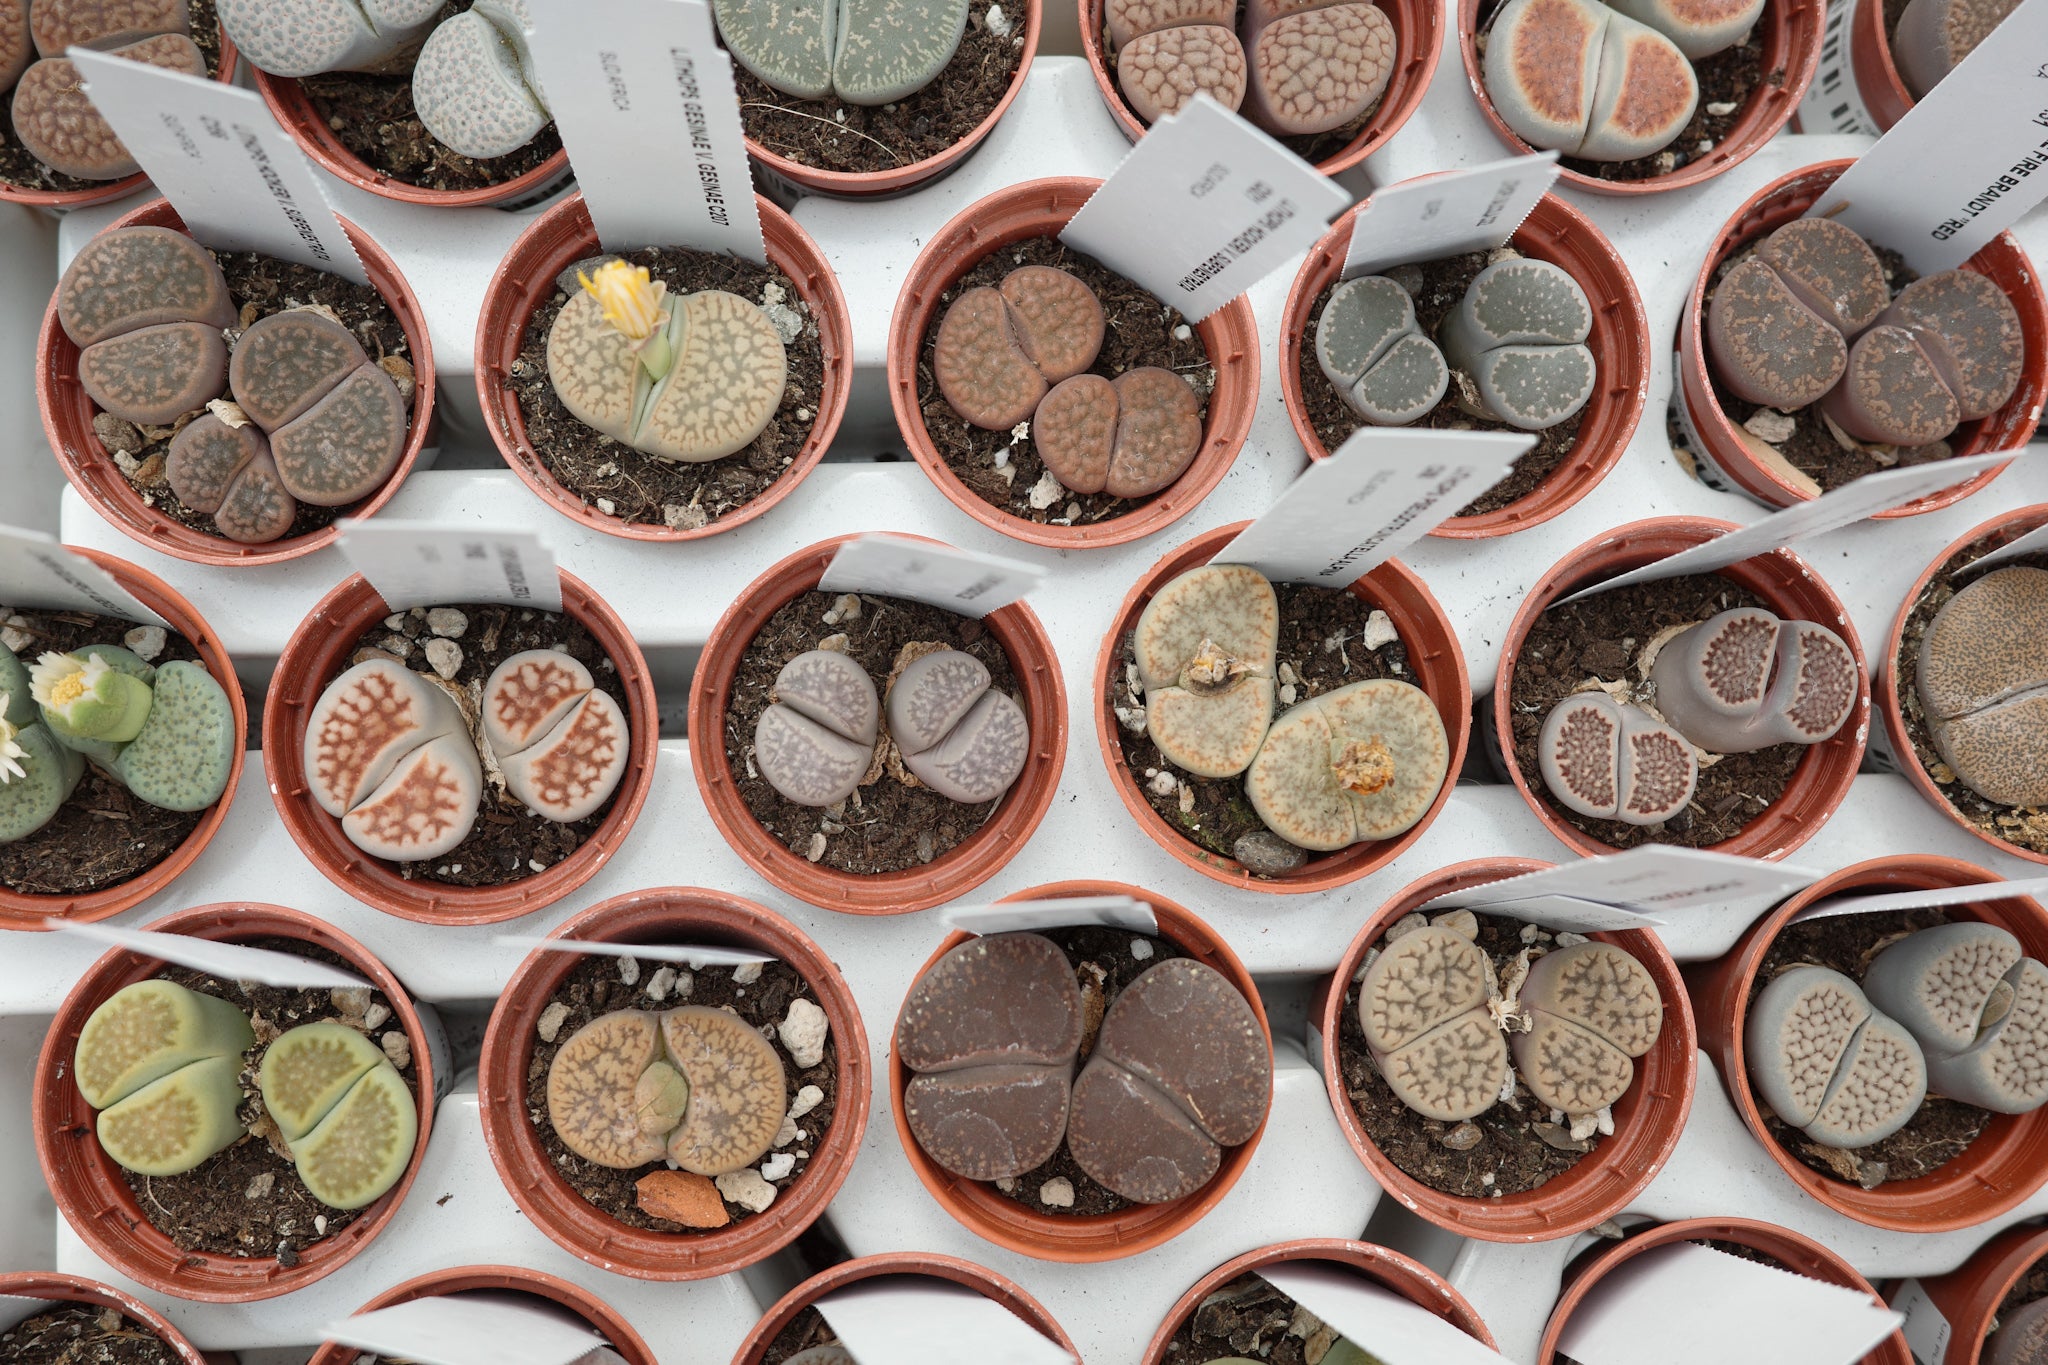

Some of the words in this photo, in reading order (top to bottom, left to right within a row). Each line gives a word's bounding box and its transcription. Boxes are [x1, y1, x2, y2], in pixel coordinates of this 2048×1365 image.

[670, 46, 701, 100] LITHOPS
[684, 103, 712, 150] GESINAE
[698, 163, 724, 205] GESINAE
[2010, 150, 2048, 177] FIRE
[709, 205, 730, 227] C207
[1961, 174, 2020, 218] BRANDT
